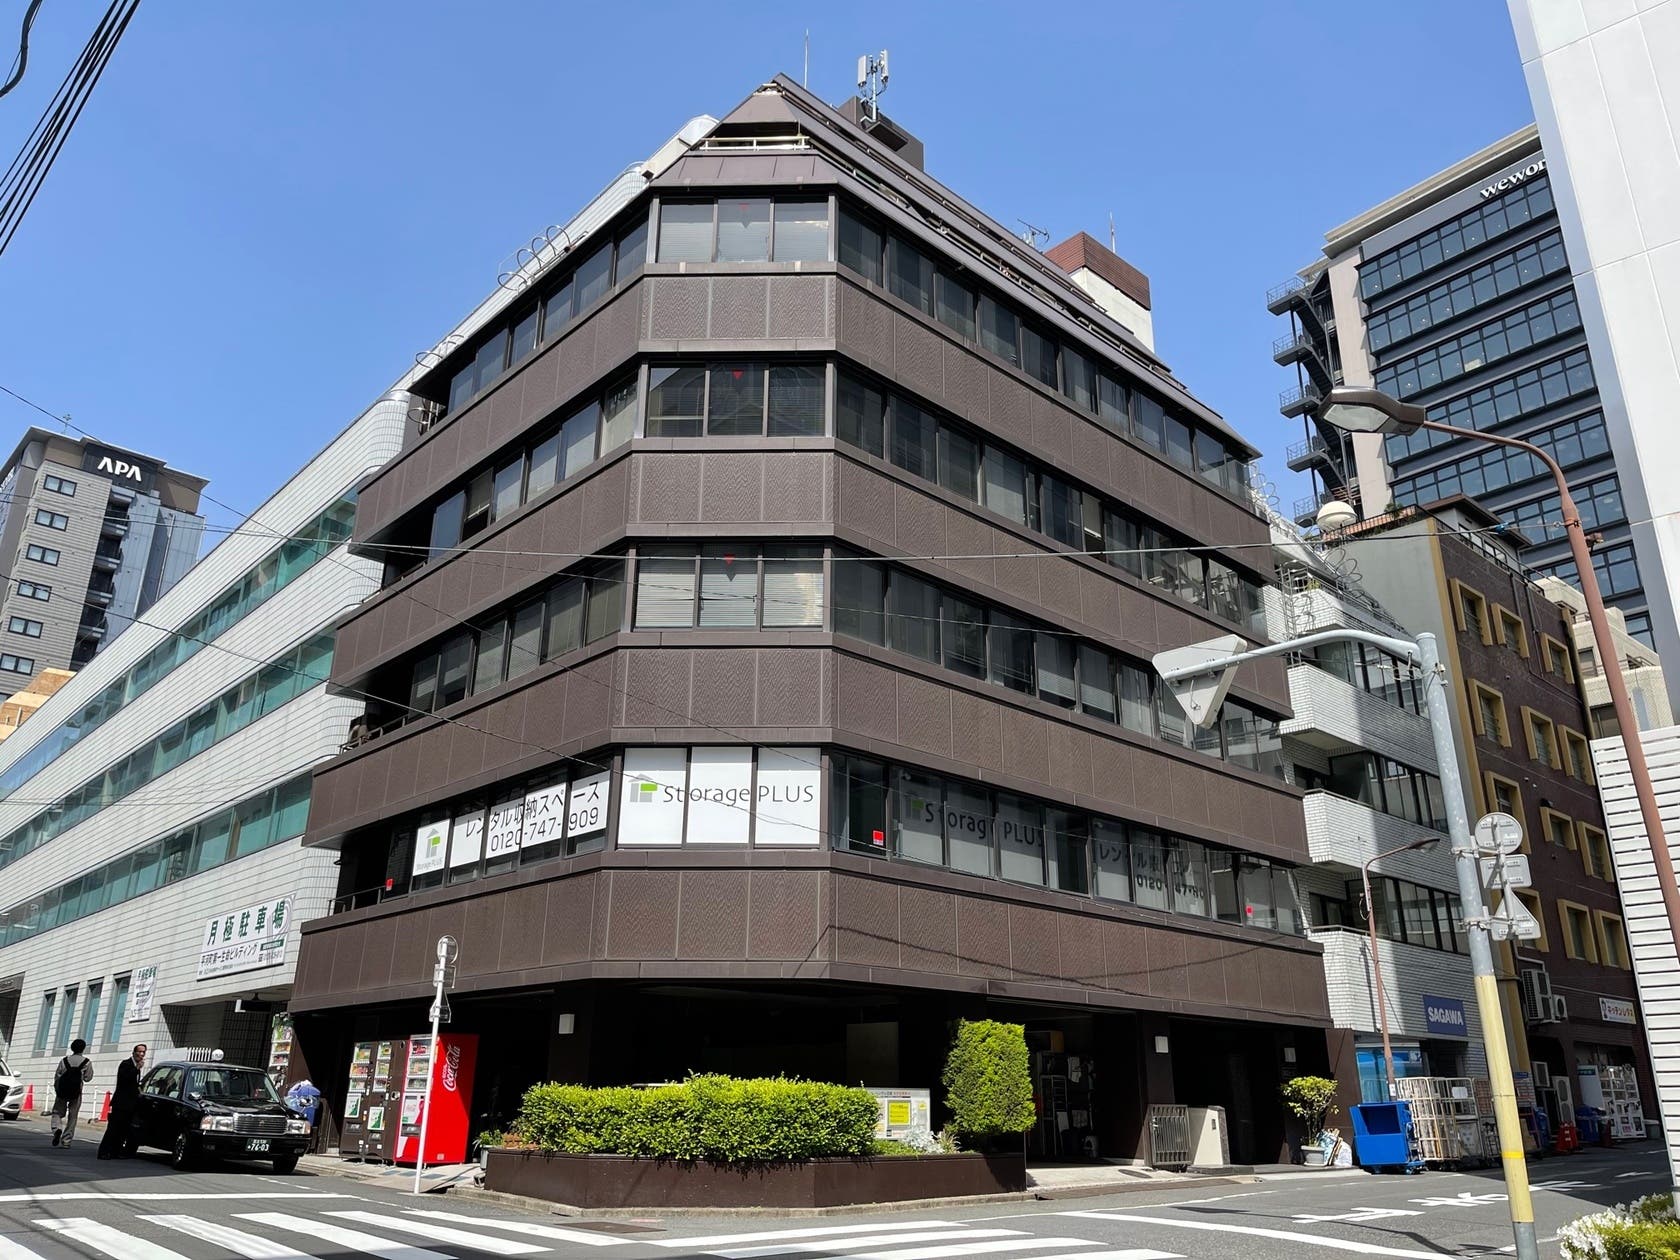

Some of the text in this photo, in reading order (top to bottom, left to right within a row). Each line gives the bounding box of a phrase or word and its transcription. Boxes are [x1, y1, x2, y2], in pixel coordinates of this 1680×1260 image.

[97, 456, 142, 482] APA
[466, 781, 600, 838] レンタル収納スペース
[664, 785, 814, 807] Storage PLUS
[491, 807, 600, 852] 0120-747-909
[207, 900, 285, 946] 月極駐車場
[1427, 1006, 1464, 1026] SAGAWA
[443, 1043, 461, 1091] Coca-Cola
